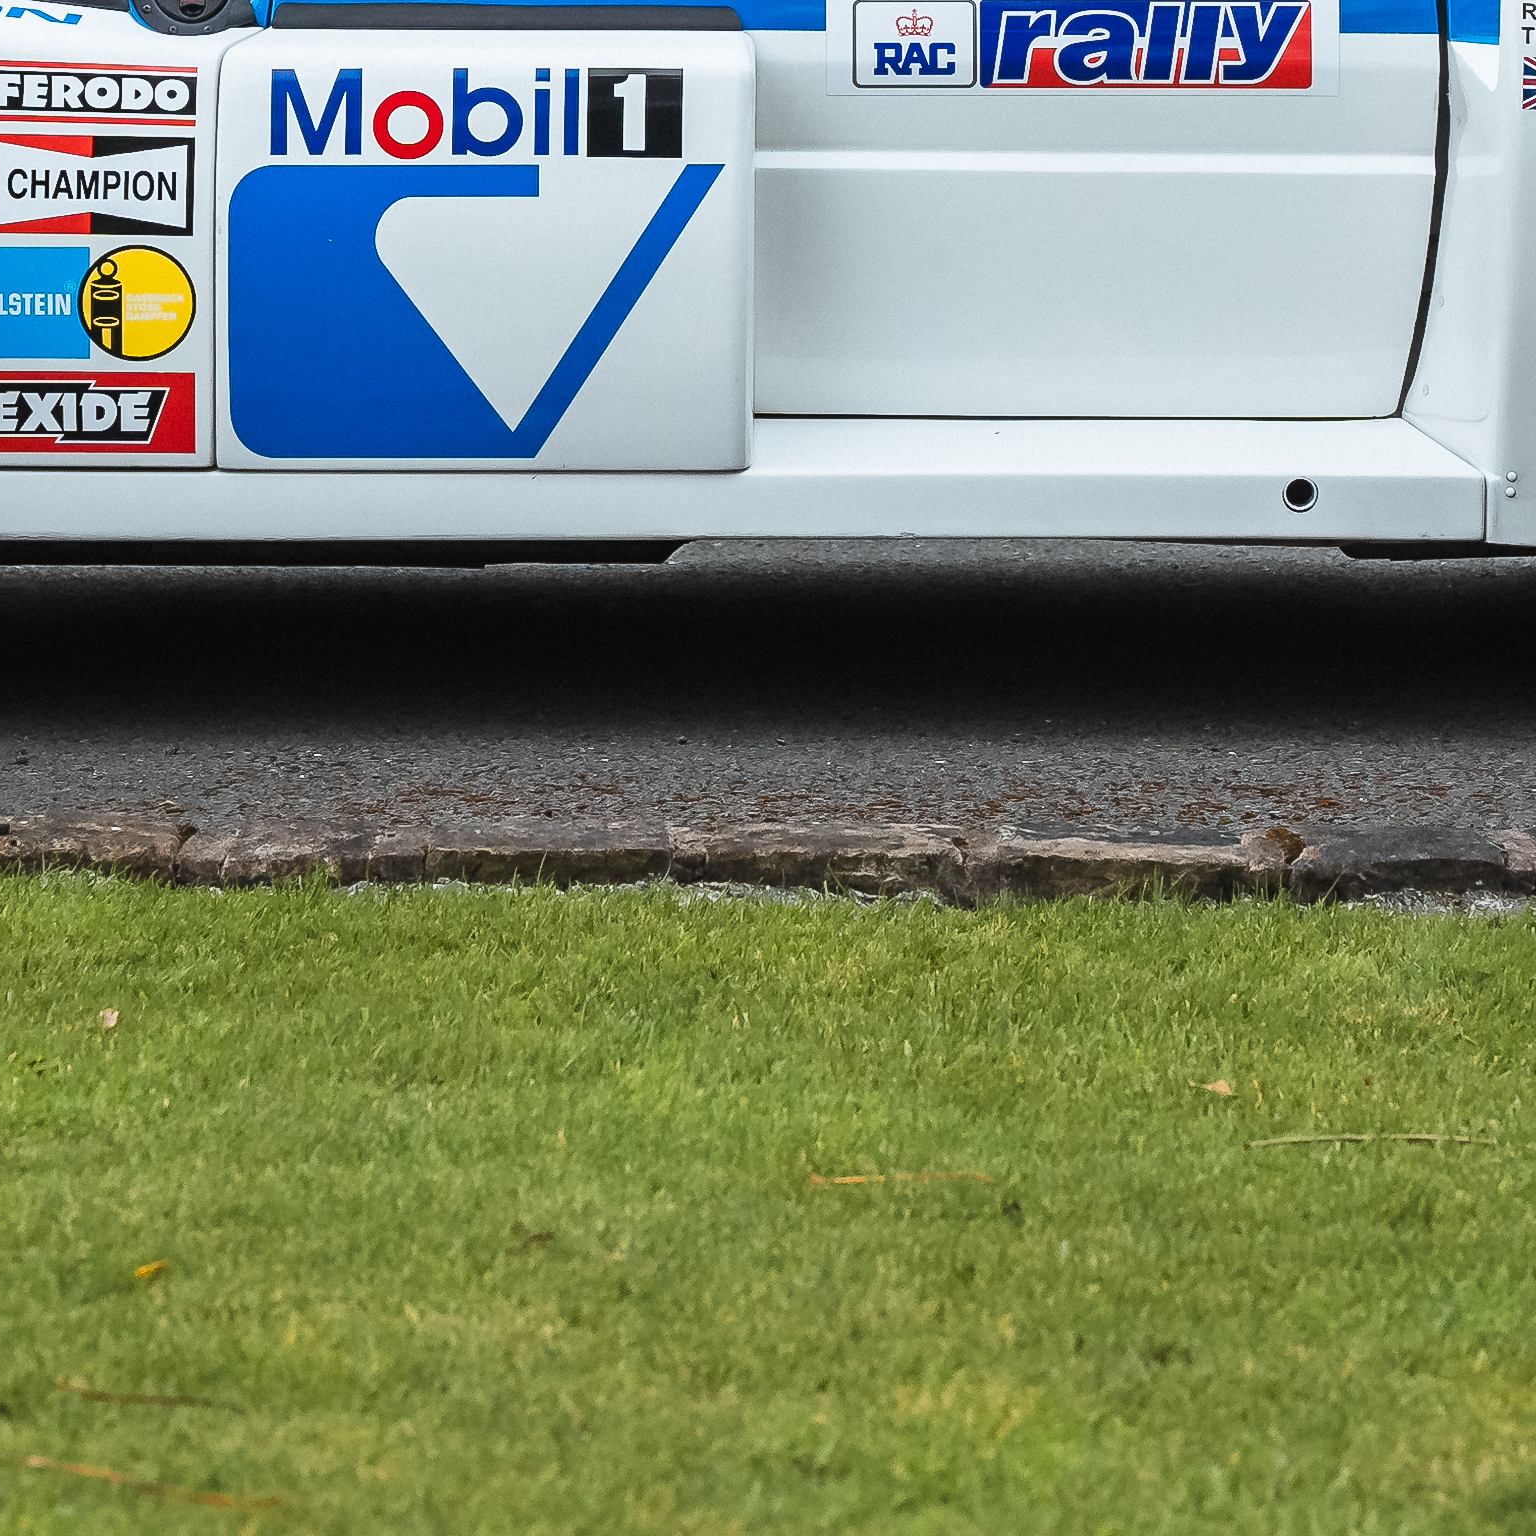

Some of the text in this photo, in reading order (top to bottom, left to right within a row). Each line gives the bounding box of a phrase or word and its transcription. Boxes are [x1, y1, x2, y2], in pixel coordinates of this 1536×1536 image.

[873, 1, 1310, 85] RAC rally
[7, 168, 178, 202] CHAMPION
